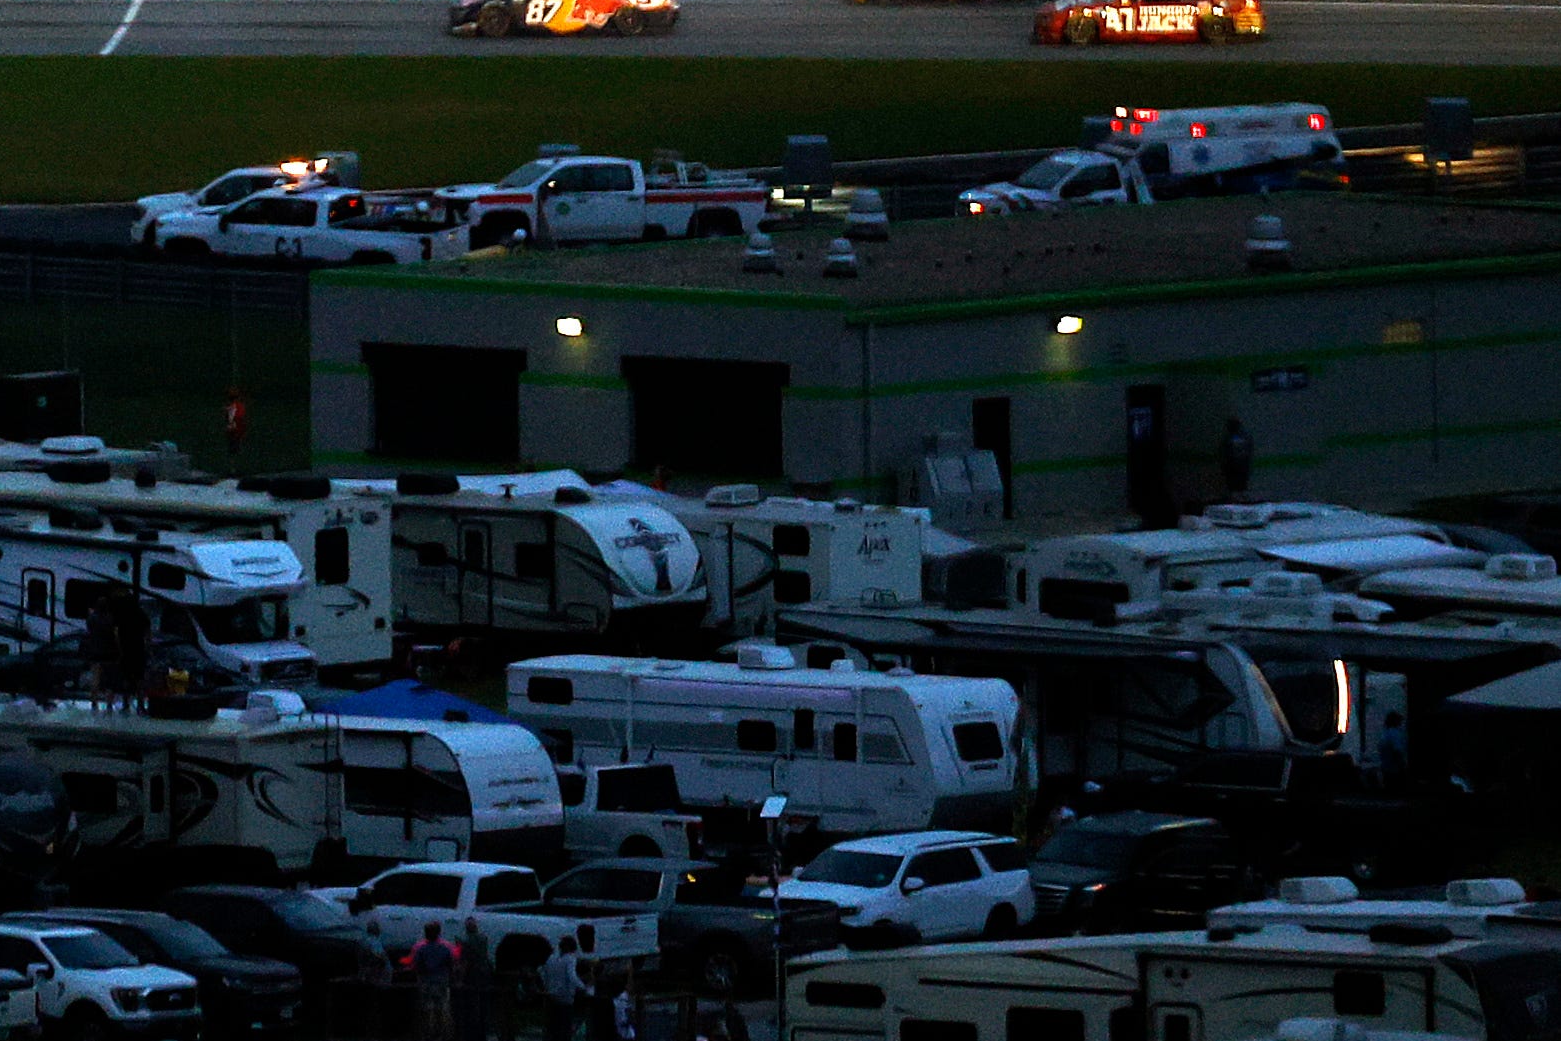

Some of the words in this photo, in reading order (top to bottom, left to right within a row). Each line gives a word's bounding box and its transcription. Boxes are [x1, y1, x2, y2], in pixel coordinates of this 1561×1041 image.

[524, 0, 563, 23] 87
[1137, 16, 1194, 31] JACK
[856, 534, 891, 559] Apex
